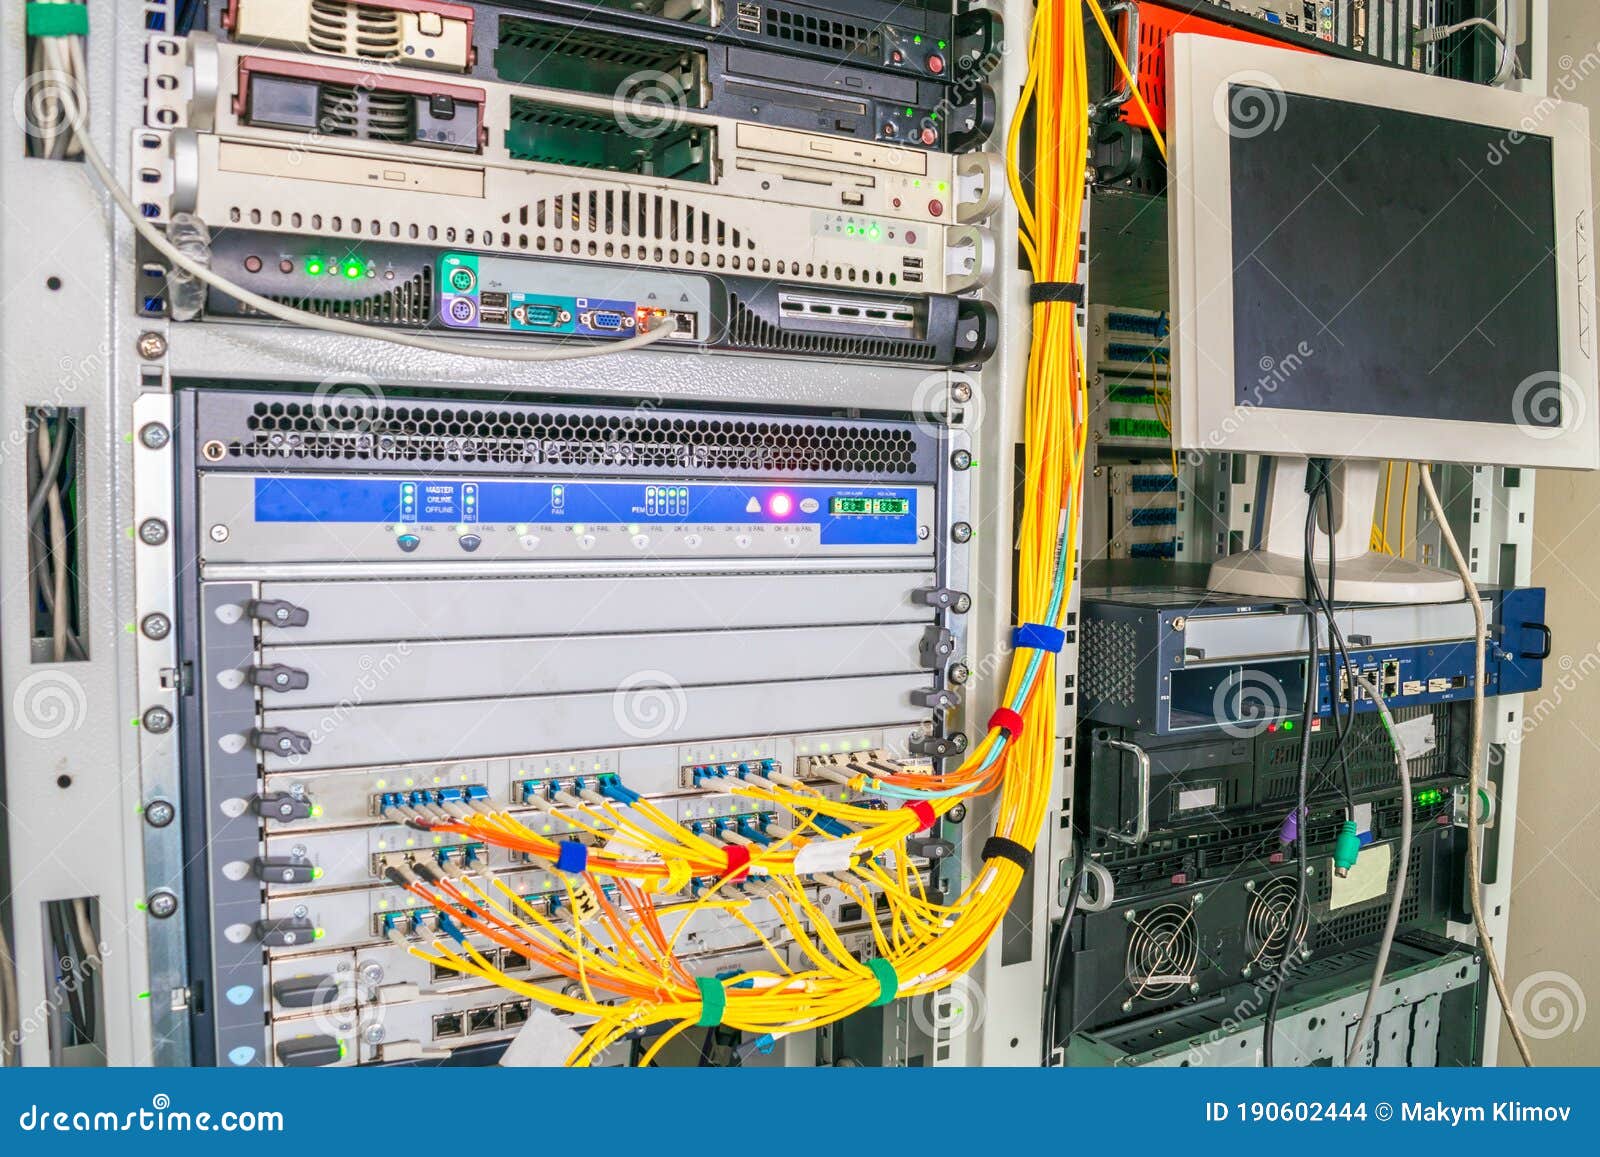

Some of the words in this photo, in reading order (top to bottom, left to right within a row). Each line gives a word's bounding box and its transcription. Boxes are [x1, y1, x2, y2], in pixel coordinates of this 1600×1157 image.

[425, 486, 453, 494] MASTER
[427, 496, 453, 504] ONLINE
[425, 506, 453, 514] OFFLINE
